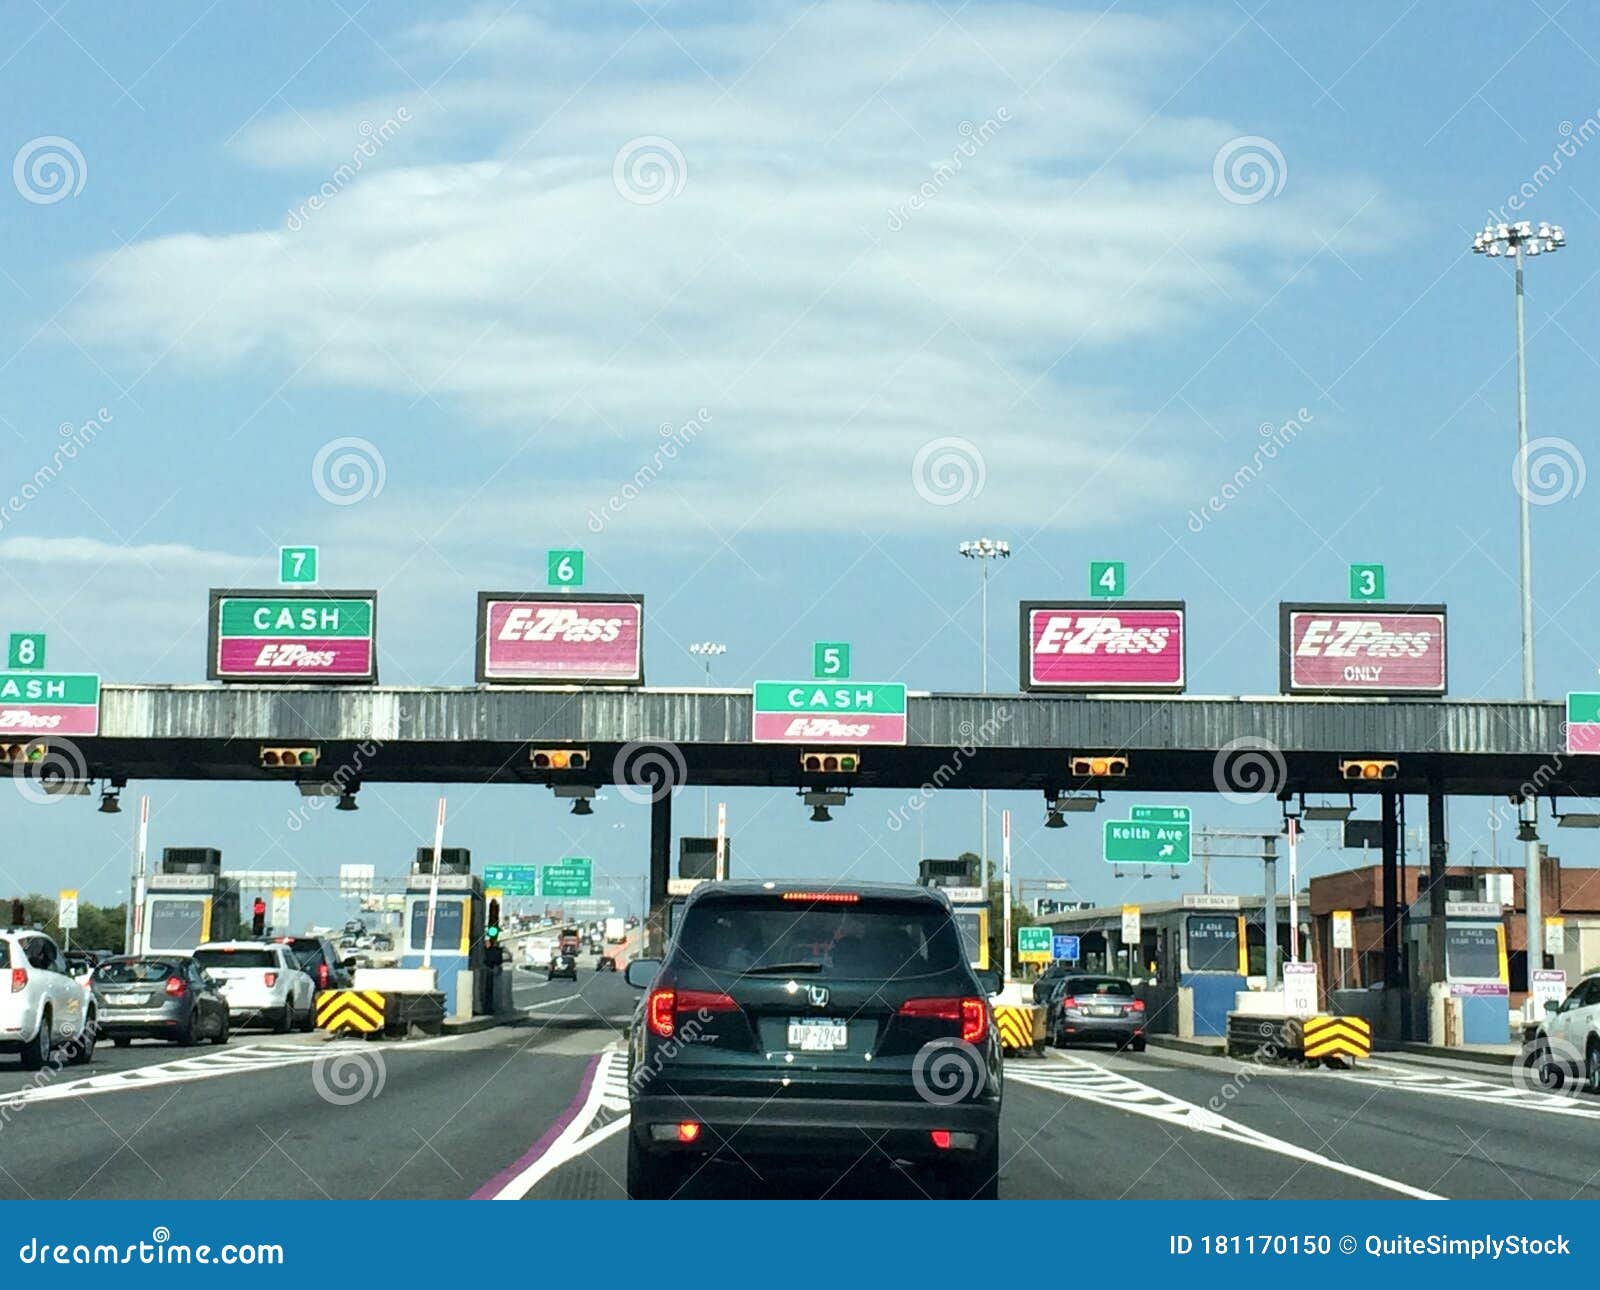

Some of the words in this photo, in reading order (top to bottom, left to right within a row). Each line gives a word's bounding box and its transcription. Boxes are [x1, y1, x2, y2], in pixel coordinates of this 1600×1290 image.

[290, 552, 306, 577] 7
[557, 557, 574, 581] 6
[1099, 567, 1116, 591] 4
[1359, 570, 1376, 595] 3
[253, 607, 340, 630] CASH
[19, 639, 35, 664] 8
[824, 649, 840, 674] 5
[1344, 666, 1382, 682] ONLY
[787, 688, 873, 708] CASH
[1112, 827, 1150, 840] Keith
[1156, 828, 1183, 841] Ave
